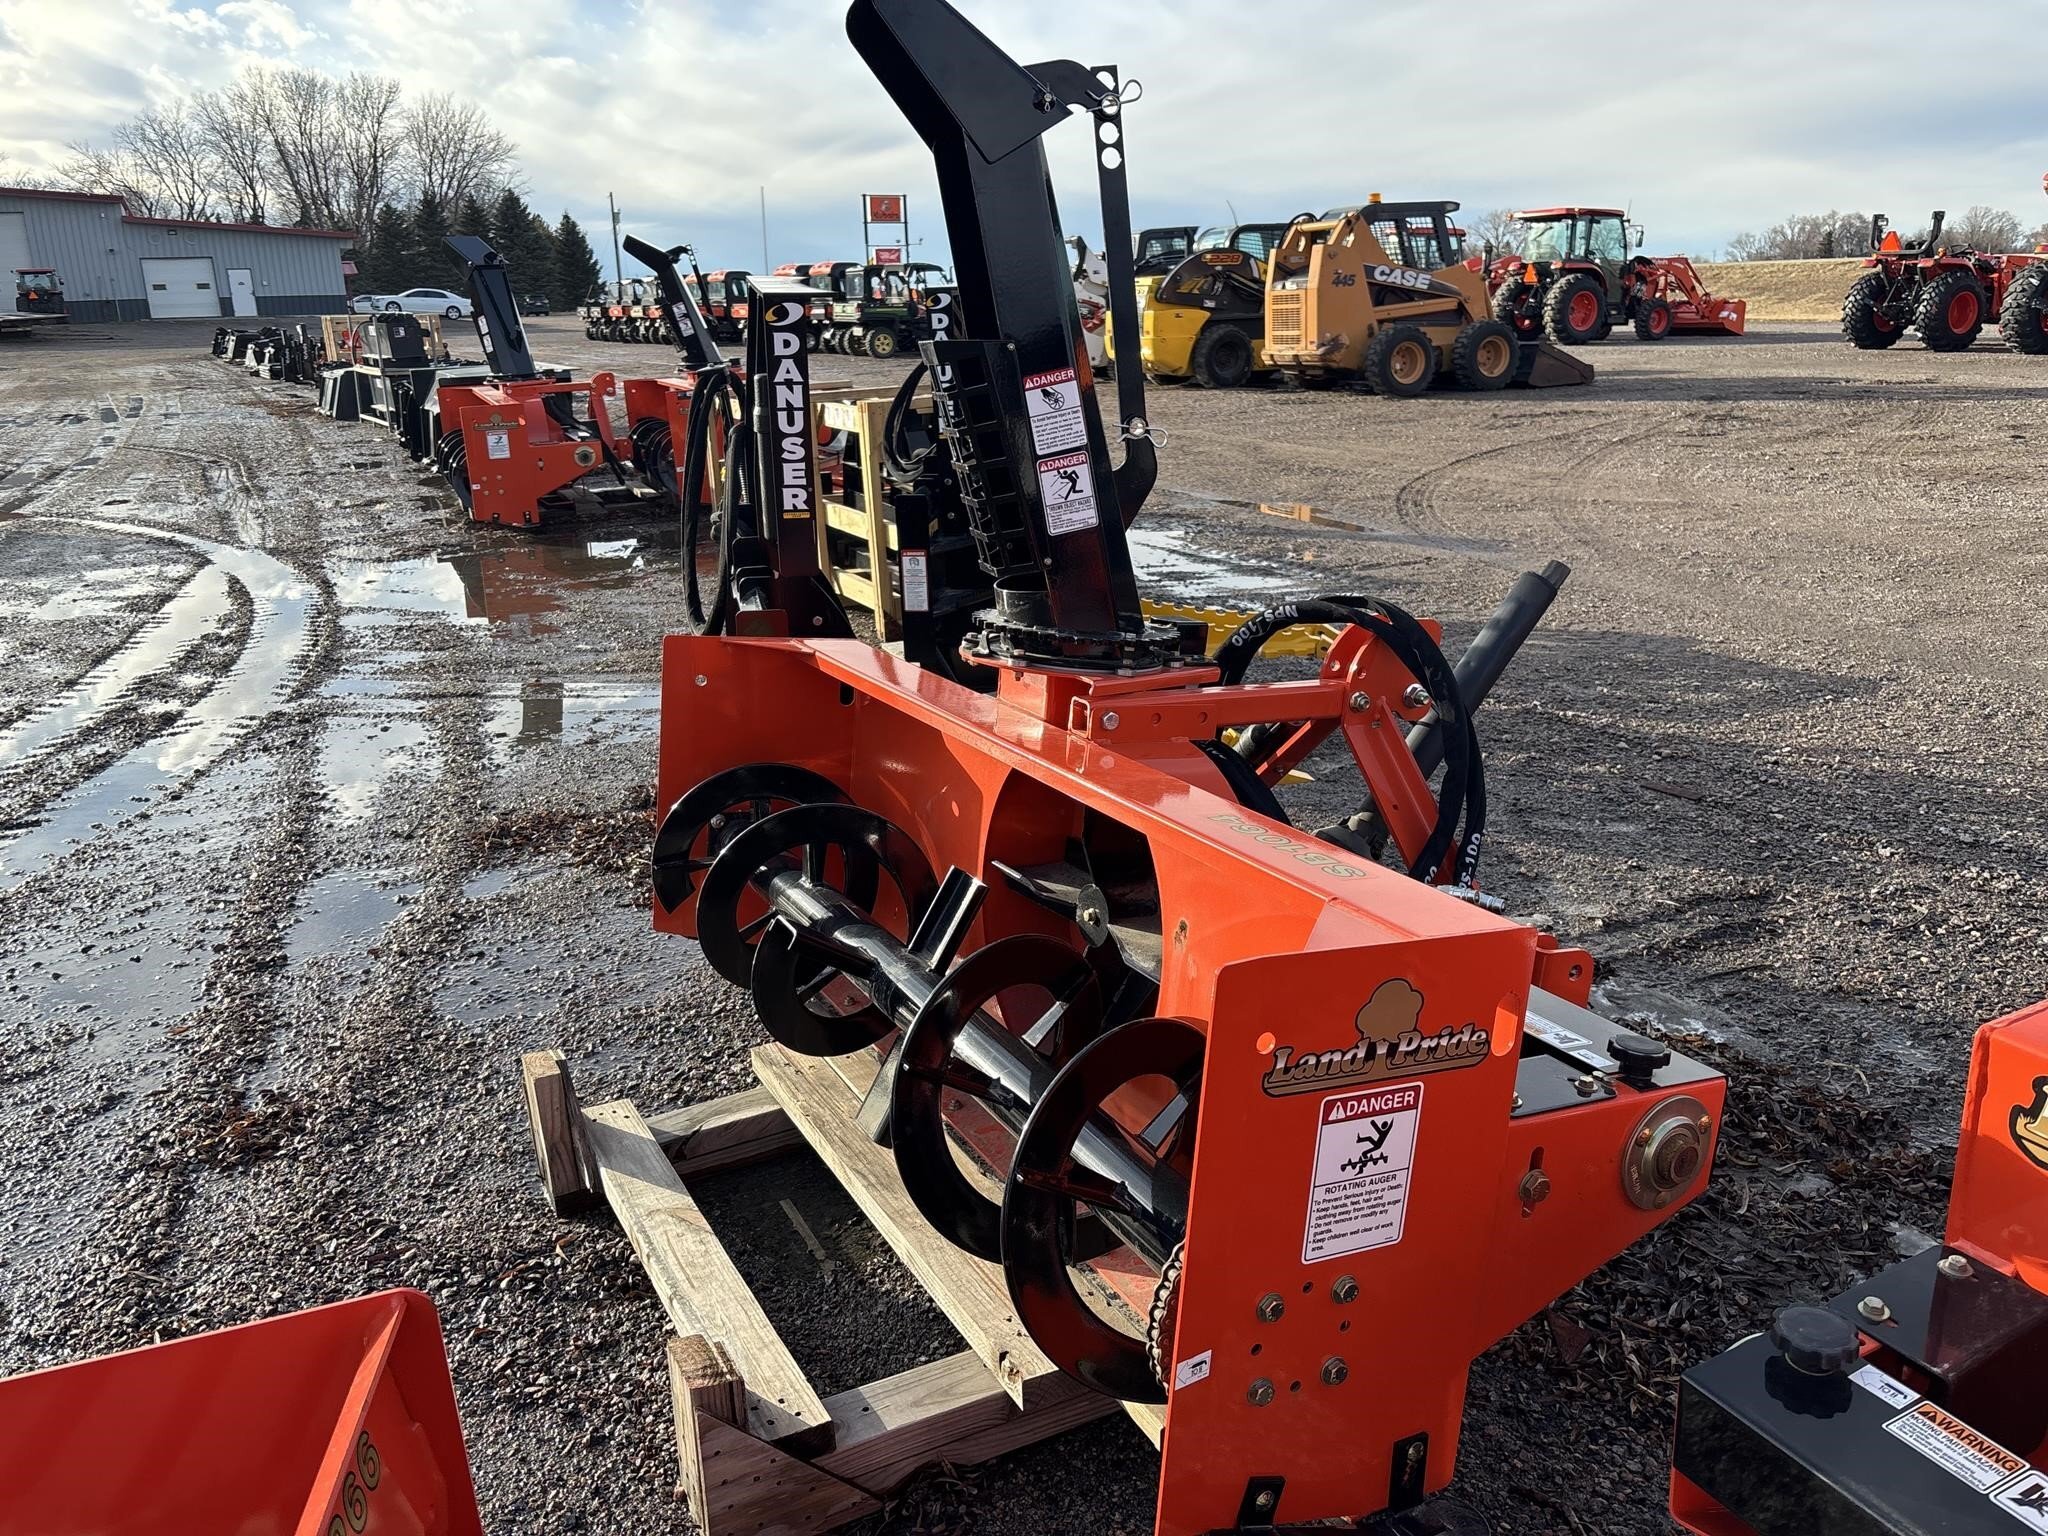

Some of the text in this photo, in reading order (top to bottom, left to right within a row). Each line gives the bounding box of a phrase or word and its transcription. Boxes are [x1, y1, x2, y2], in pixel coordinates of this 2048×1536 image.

[1331, 274, 1356, 287] 445
[1374, 265, 1432, 290] CASE
[1033, 369, 1075, 386] DANGER
[773, 332, 809, 510] DANUSER
[1047, 454, 1087, 470] DANGER
[1231, 605, 1299, 647] NPS-100
[1208, 815, 1368, 878] SB1064
[1269, 1037, 1371, 1083] Land
[1390, 1023, 1488, 1066] Pride
[1346, 1091, 1415, 1117] DANGER
[1324, 1174, 1397, 1195] ROTATING AUGER
[1316, 1205, 1330, 1213] Keep
[1331, 1202, 1349, 1210] hands,
[1362, 1196, 1372, 1204] hair
[1322, 1197, 1342, 1205] Prevent
[1343, 1192, 1363, 1200] Serious
[1364, 1189, 1379, 1197] Injury
[1315, 1212, 1337, 1221] clothing
[1338, 1209, 1351, 1217] away
[1366, 1201, 1386, 1210] rotating
[1333, 1216, 1353, 1225] remove
[1360, 1210, 1378, 1219] modify
[1312, 1236, 1326, 1244] Keep
[1327, 1231, 1349, 1241] children
[1349, 1228, 1360, 1236] well
[1360, 1226, 1373, 1234] clear
[1380, 1221, 1394, 1229] work
[1313, 1228, 1333, 1238] guards.
[1311, 1245, 1324, 1253] area.
[1909, 1413, 2006, 1477] MOVING PARTS HAZARD
[1936, 1416, 2020, 1472] WARNING
